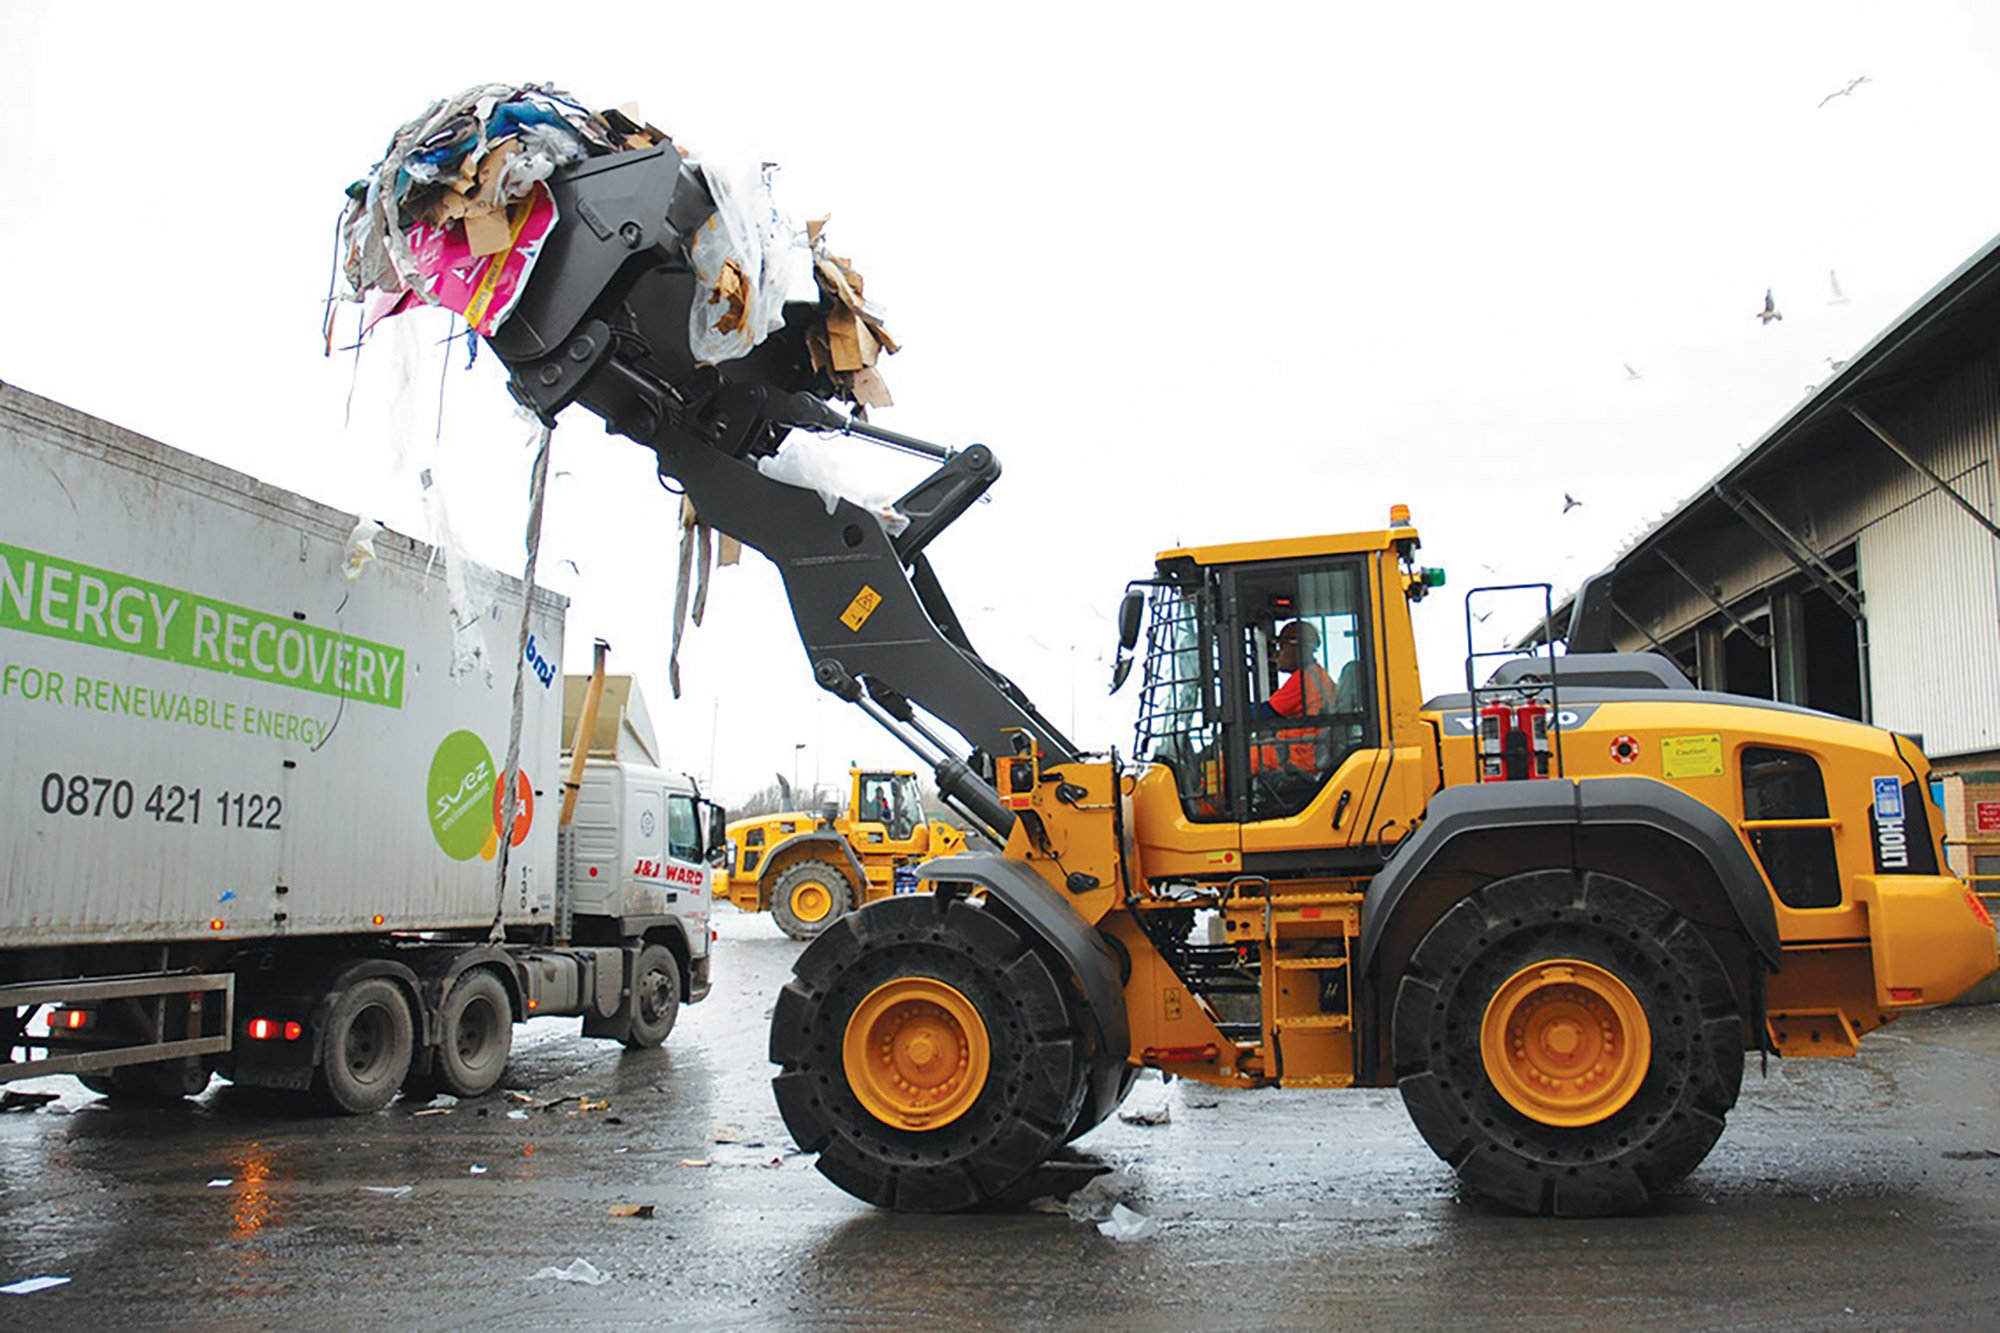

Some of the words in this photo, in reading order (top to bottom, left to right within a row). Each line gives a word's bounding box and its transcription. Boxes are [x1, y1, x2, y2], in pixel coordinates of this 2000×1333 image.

[0, 554, 180, 649] NERGY
[193, 605, 399, 698] RECOVERY
[526, 634, 556, 689] bmi
[3, 665, 63, 704] FOR
[74, 676, 236, 730] RENEWABLE
[243, 706, 328, 745] ENERGY
[41, 772, 133, 819] 0870
[144, 784, 201, 824] 421
[217, 791, 282, 830] 1122
[1878, 820, 1908, 867] L110H
[633, 860, 661, 878] J&J
[666, 866, 703, 885] WARD
